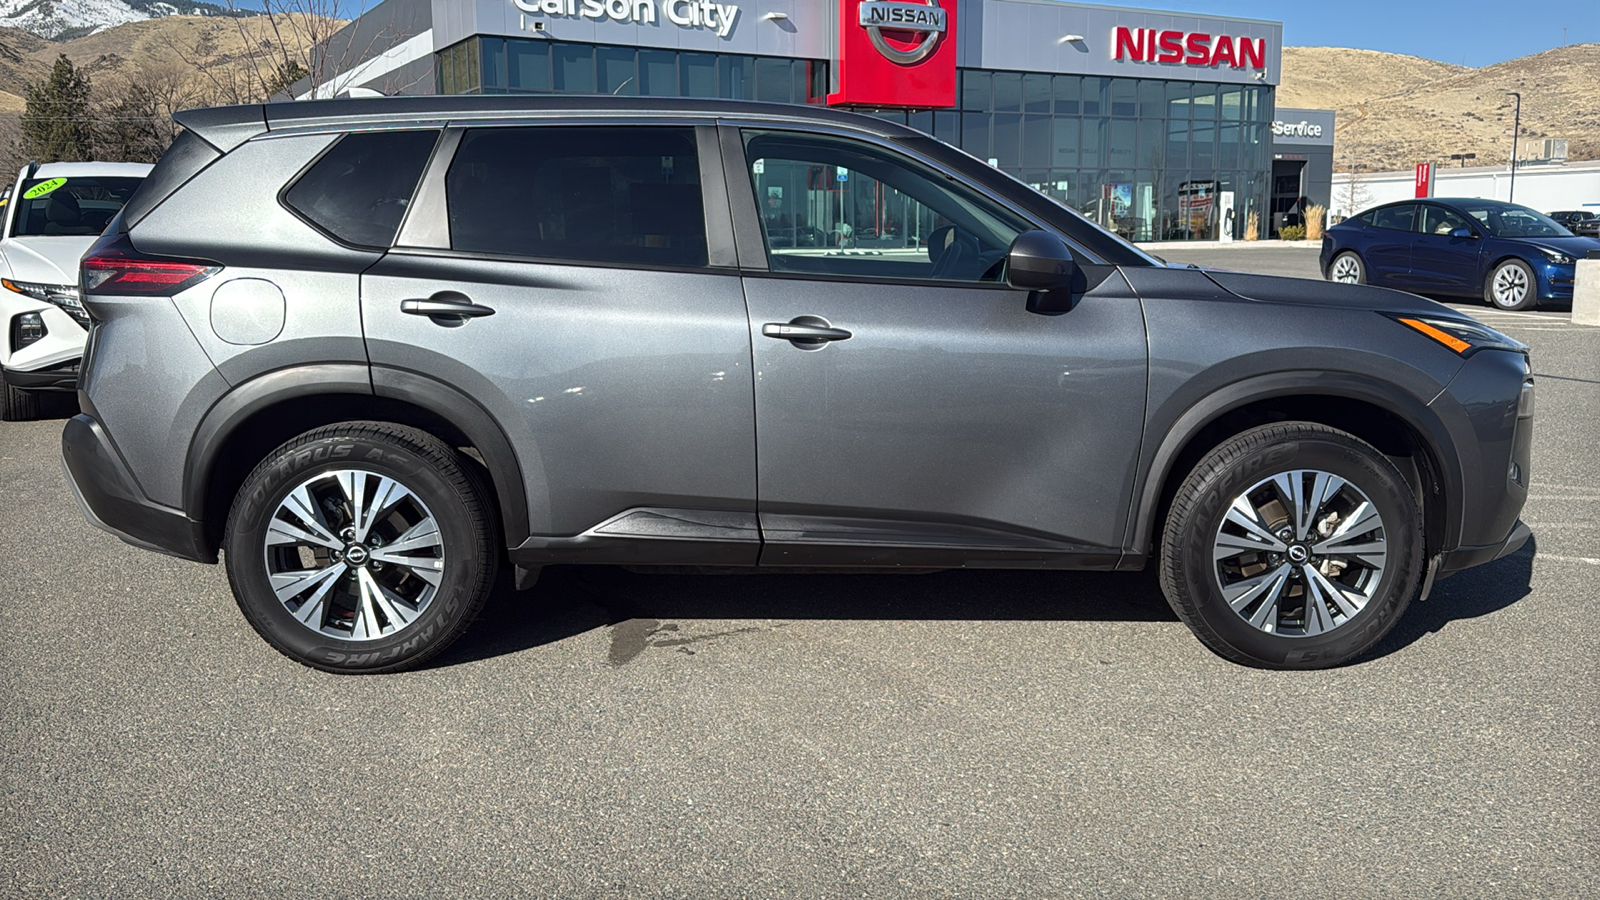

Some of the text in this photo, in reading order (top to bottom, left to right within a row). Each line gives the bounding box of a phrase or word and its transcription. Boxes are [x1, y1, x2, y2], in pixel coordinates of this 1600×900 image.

[665, 0, 738, 37] City
[871, 7, 940, 26] NISSAN
[1113, 26, 1266, 69] NISSAN
[1274, 120, 1322, 136] Service
[30, 180, 58, 196] 2024
[243, 444, 355, 520] SOLARUS
[1189, 447, 1285, 566] STARFIRE
[325, 597, 460, 667] STARFIRE
